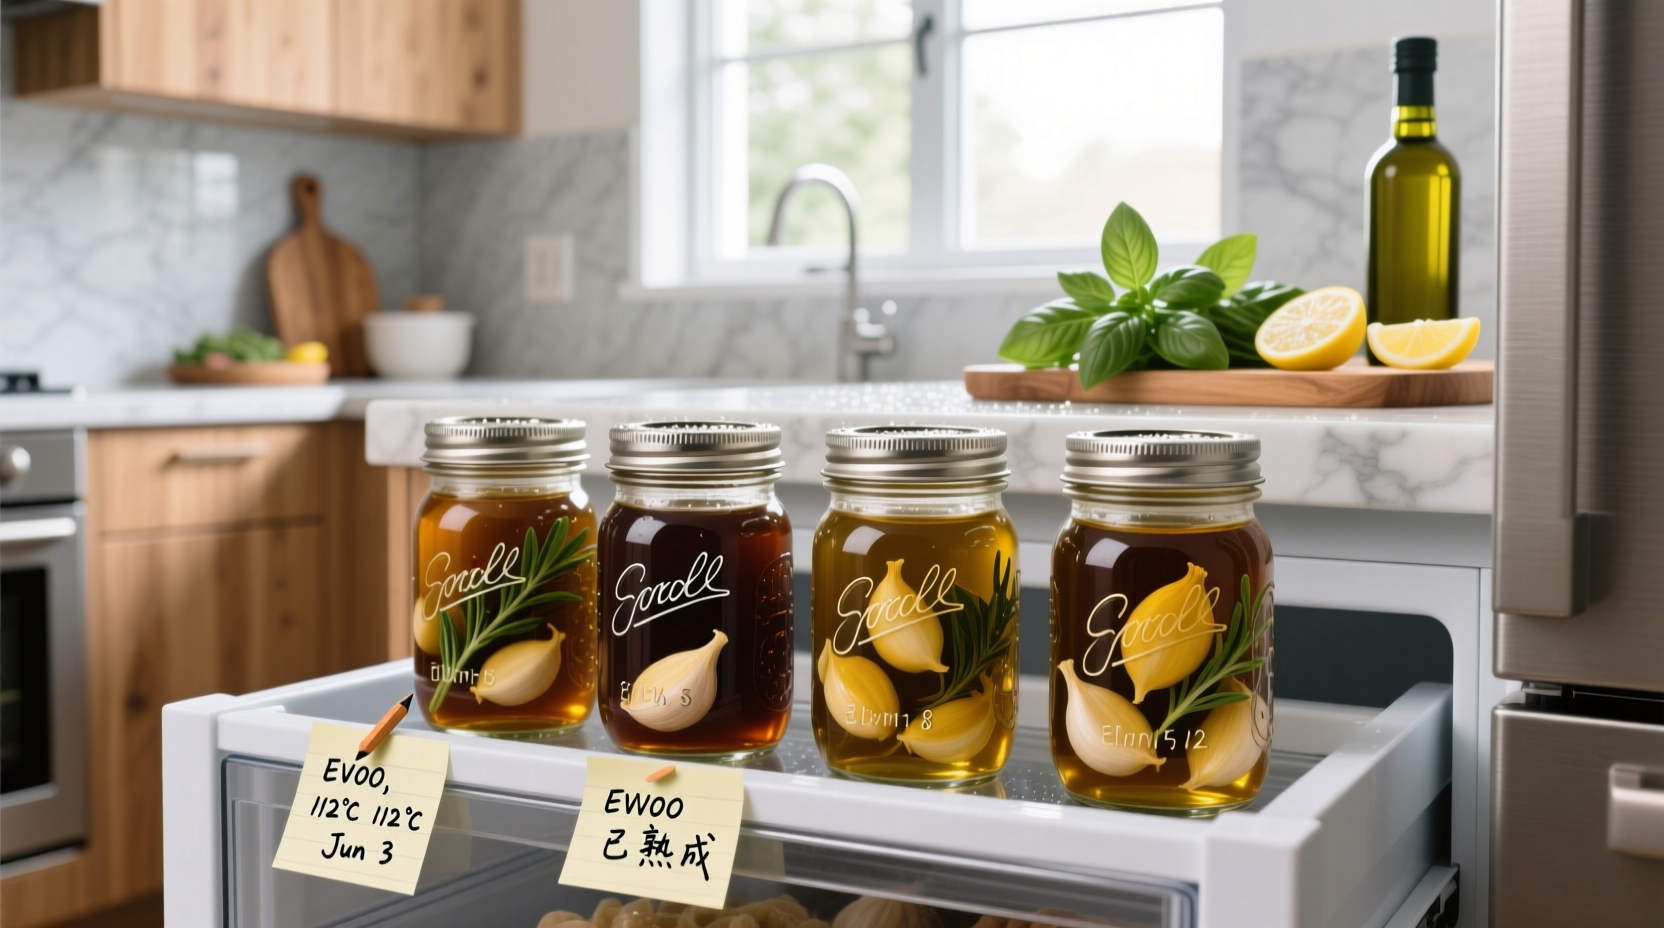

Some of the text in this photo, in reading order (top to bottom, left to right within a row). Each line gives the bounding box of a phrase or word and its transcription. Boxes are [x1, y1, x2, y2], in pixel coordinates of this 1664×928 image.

[323, 758, 389, 795] EVOO,
[604, 789, 684, 819] EWOO
[321, 832, 393, 865] Jun 3
